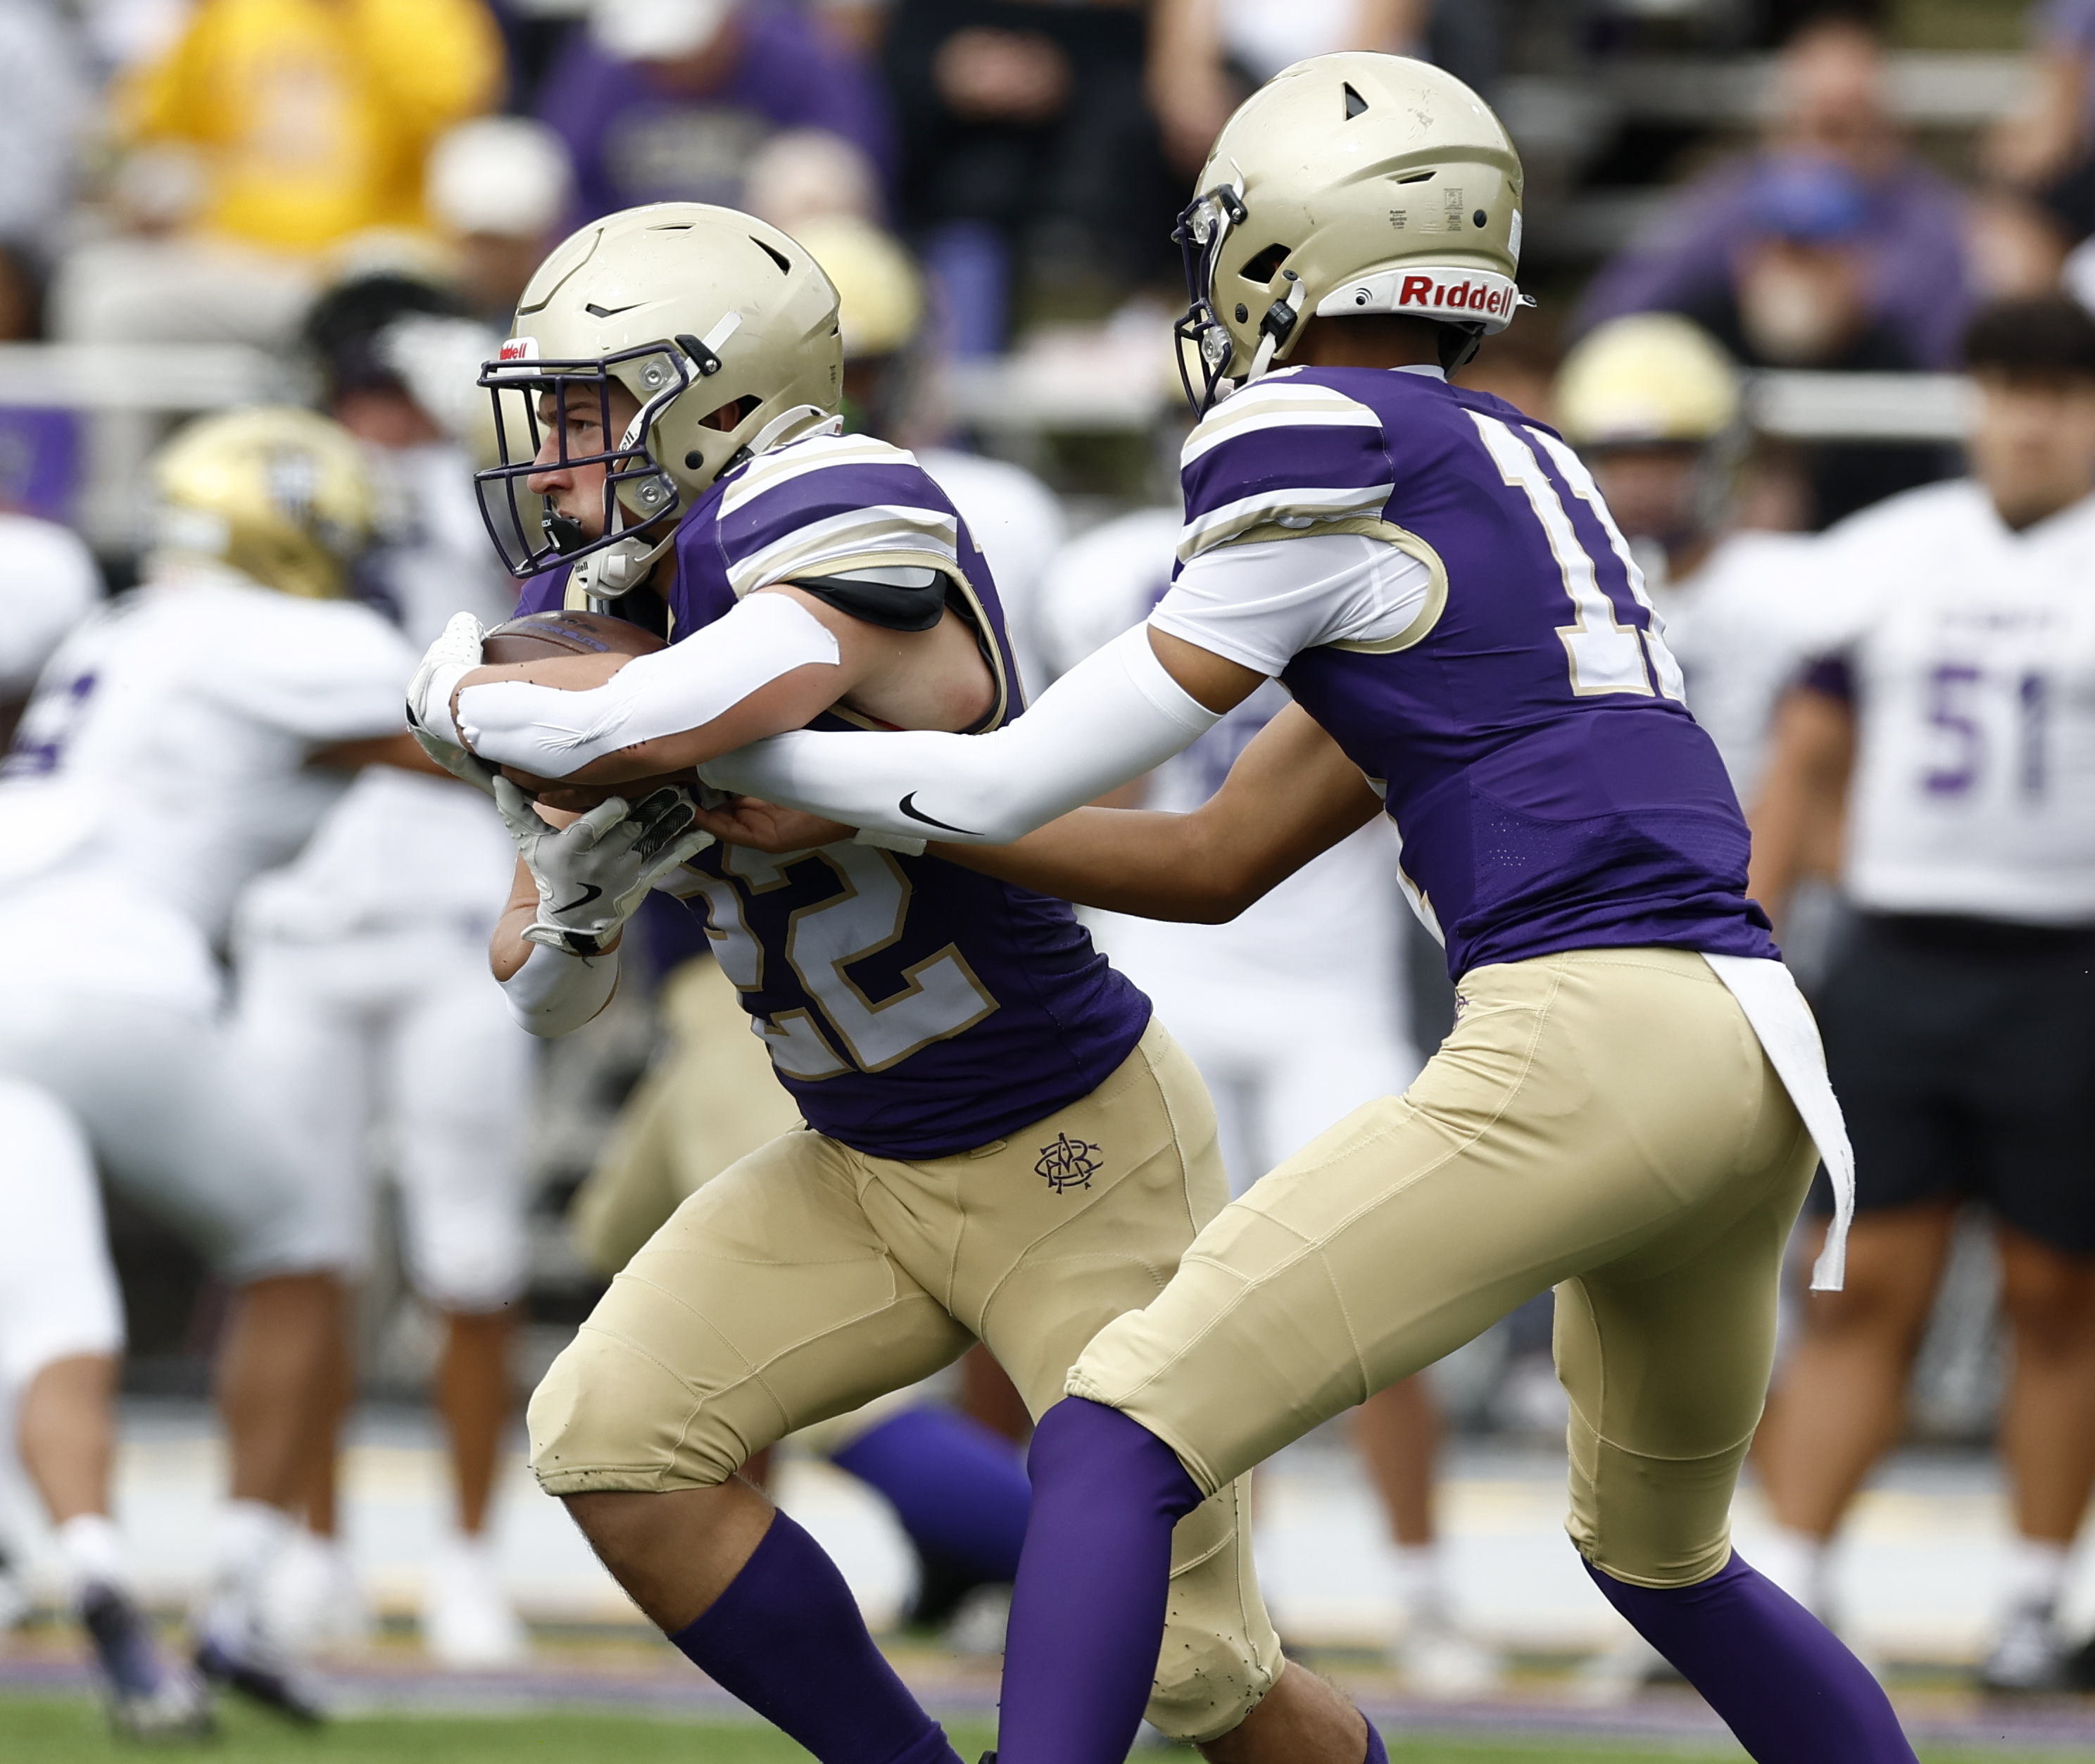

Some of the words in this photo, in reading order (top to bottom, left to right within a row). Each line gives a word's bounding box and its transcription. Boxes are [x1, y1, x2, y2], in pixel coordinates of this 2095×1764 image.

[1398, 275, 1514, 318] Riddell
[1459, 407, 1687, 707] 11
[1924, 664, 2049, 809] 51
[652, 838, 1001, 1083] 22
